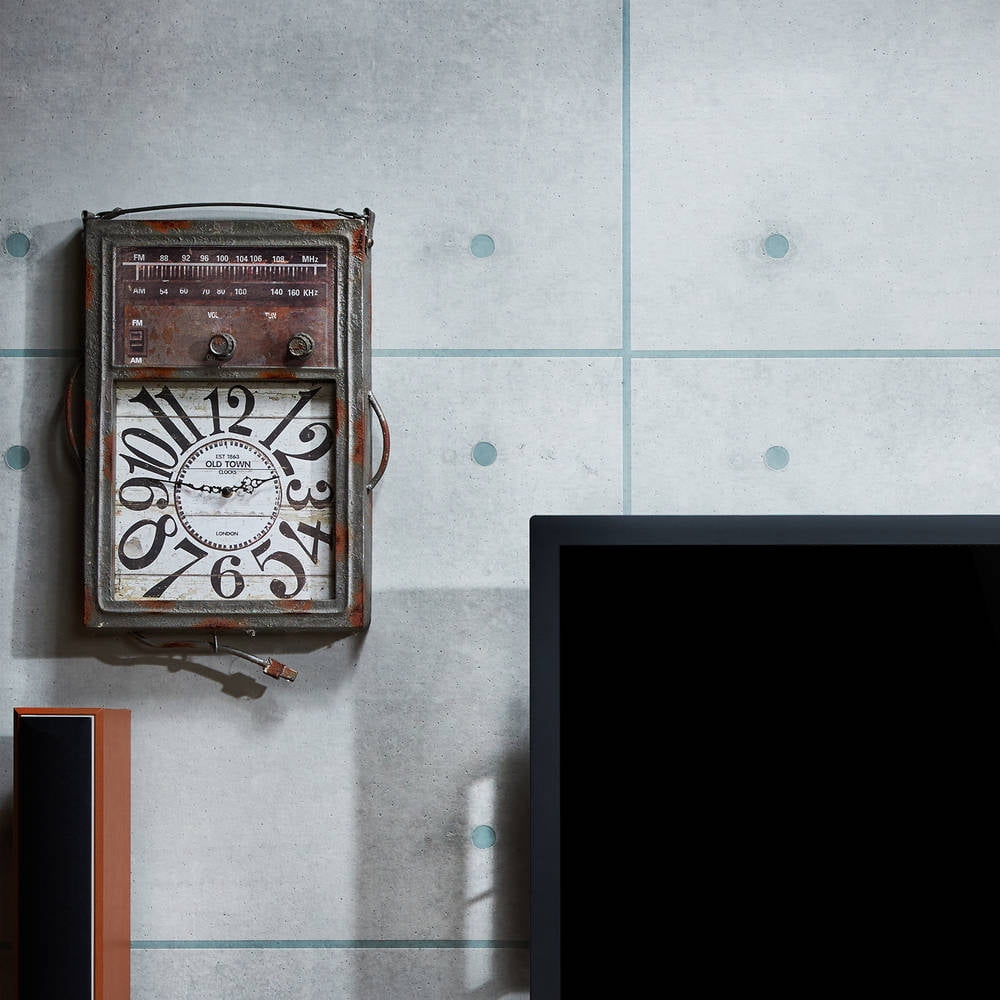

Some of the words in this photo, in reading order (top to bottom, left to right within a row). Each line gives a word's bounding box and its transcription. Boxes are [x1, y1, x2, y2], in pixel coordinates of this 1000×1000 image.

[132, 319, 143, 327] FM
[129, 385, 207, 455] 11
[203, 385, 255, 436] 12
[258, 386, 322, 450] 1
[119, 428, 179, 481] 10
[205, 460, 222, 468] OLD
[225, 460, 251, 468] TOWN
[273, 422, 333, 476] 2
[119, 477, 169, 511] 9
[287, 479, 333, 511] 3
[118, 514, 178, 571] 8
[143, 537, 208, 598] 7
[251, 539, 306, 598] 5
[279, 520, 333, 565] 4
[210, 555, 245, 598] 6
